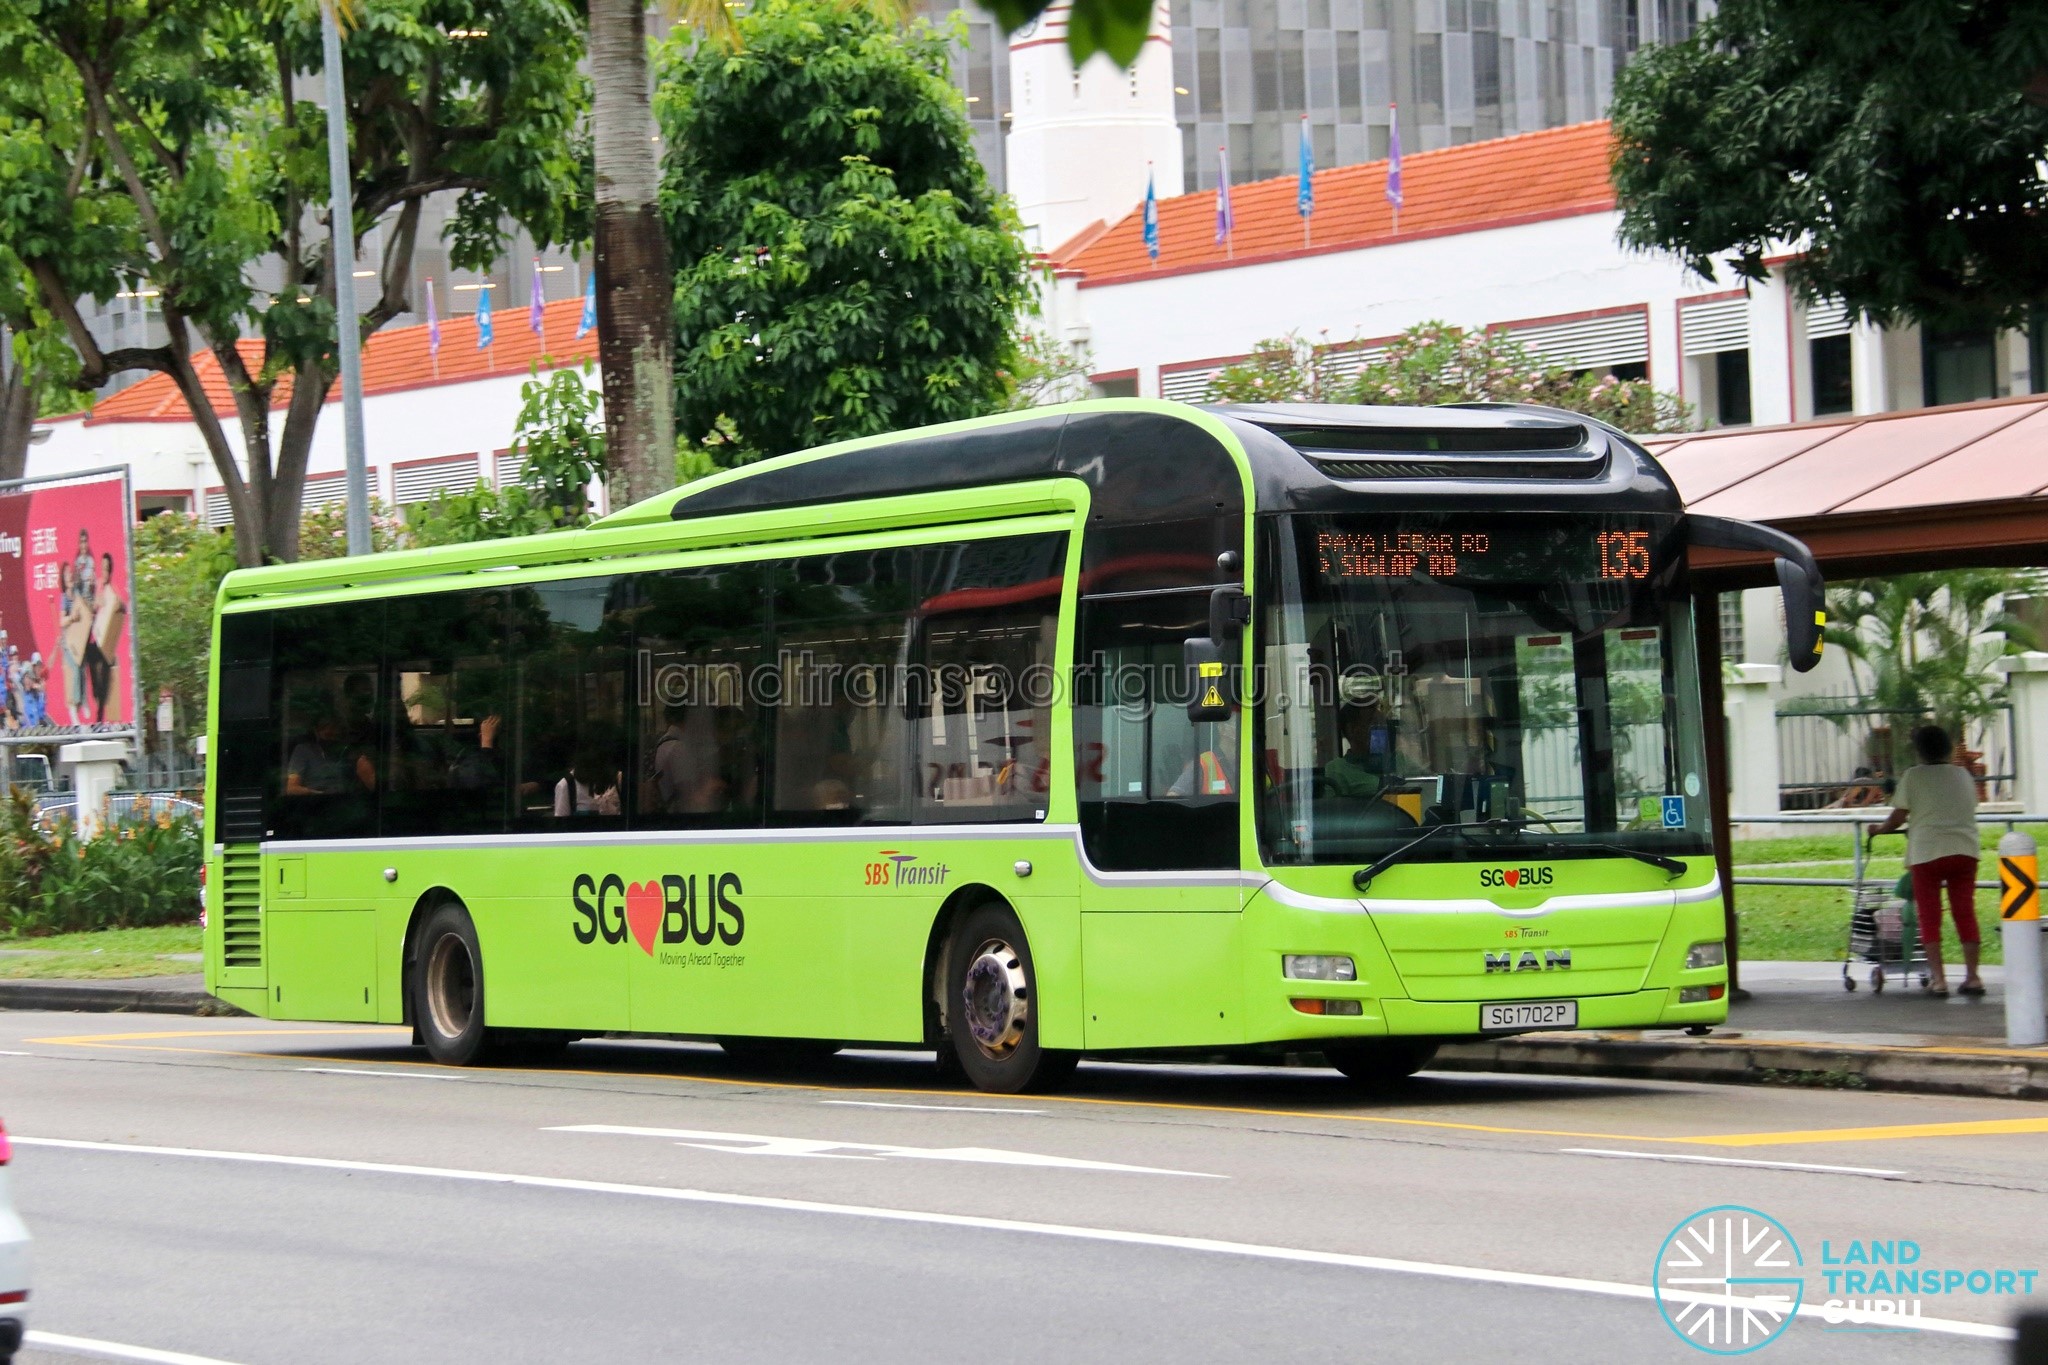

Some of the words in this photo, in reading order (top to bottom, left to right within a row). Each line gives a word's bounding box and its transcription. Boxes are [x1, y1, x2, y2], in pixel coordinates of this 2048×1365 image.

[1319, 534, 1376, 552] PAYA
[1383, 534, 1453, 552] LEBAR
[1461, 534, 1489, 552] RD
[1597, 531, 1649, 578] 135
[1341, 555, 1418, 576] SIGLAP
[1429, 555, 1457, 576] RD
[865, 862, 889, 886] SBS
[888, 855, 951, 889] Transit
[1480, 868, 1505, 887] SG
[1518, 867, 1553, 885] BUS
[573, 873, 628, 946] SG
[662, 872, 745, 946] BUS
[1504, 930, 1518, 939] SBS
[1520, 927, 1549, 939] Transit
[660, 952, 687, 969] Moving
[687, 952, 712, 966] Ahead
[713, 952, 745, 969] Together
[1484, 949, 1572, 973] MAN
[1491, 1005, 1566, 1025] SG1702P
